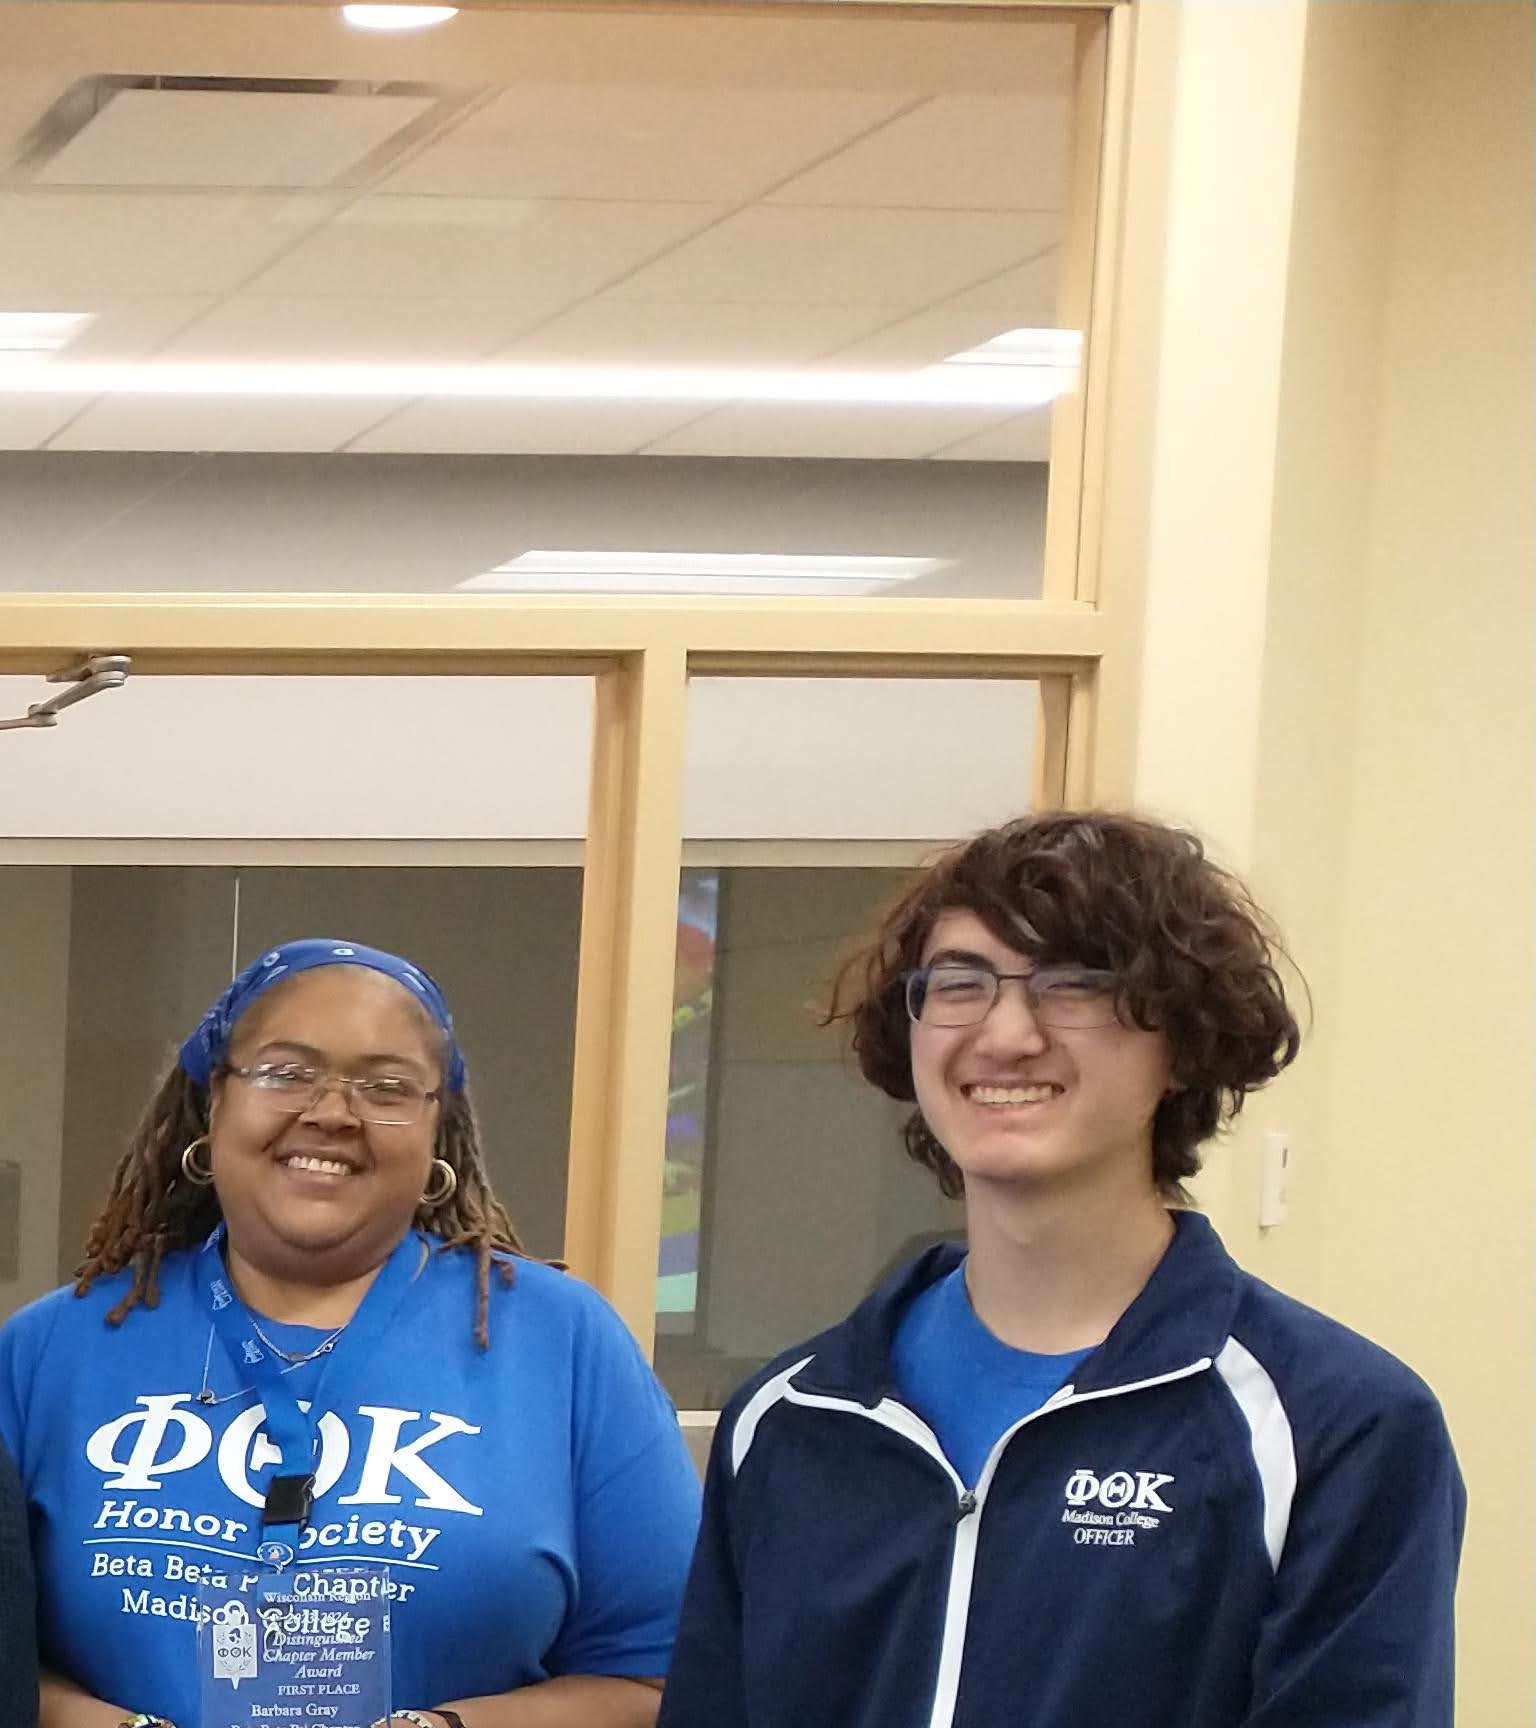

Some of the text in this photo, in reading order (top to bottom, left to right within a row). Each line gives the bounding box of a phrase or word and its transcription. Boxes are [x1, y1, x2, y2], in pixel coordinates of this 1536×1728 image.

[1062, 1509, 1160, 1529] Madison College
[93, 1500, 441, 1560] Honor ociety
[1074, 1528, 1136, 1546] OFFICER
[91, 1553, 153, 1578] Beta
[164, 1555, 228, 1588] Beta
[293, 1571, 415, 1605] Chapter
[263, 1648, 376, 1665] Chapter Member
[295, 1664, 343, 1679] Award
[278, 1684, 361, 1696] FIRST PLACE
[251, 1703, 339, 1718] Barbara Gray
